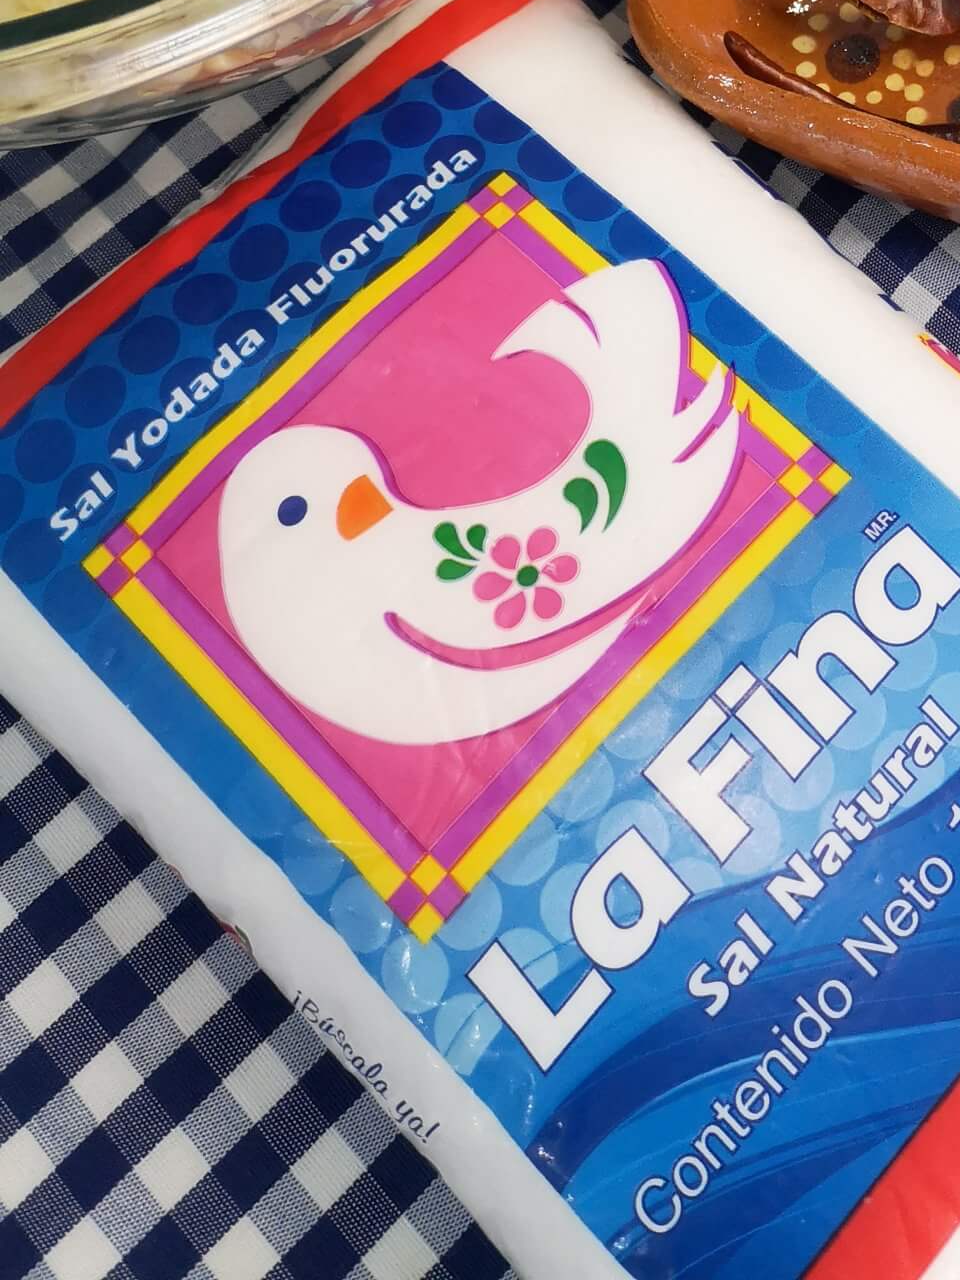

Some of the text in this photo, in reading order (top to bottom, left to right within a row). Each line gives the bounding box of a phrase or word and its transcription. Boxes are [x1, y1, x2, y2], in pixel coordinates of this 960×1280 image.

[49, 148, 478, 542] Sal Yodada Fluorurada
[466, 825, 694, 1075] La
[688, 695, 960, 1017] Sal Natural
[394, 1099, 441, 1144] ya!
[633, 978, 854, 1235] Contenido
[840, 855, 955, 980] Neto
